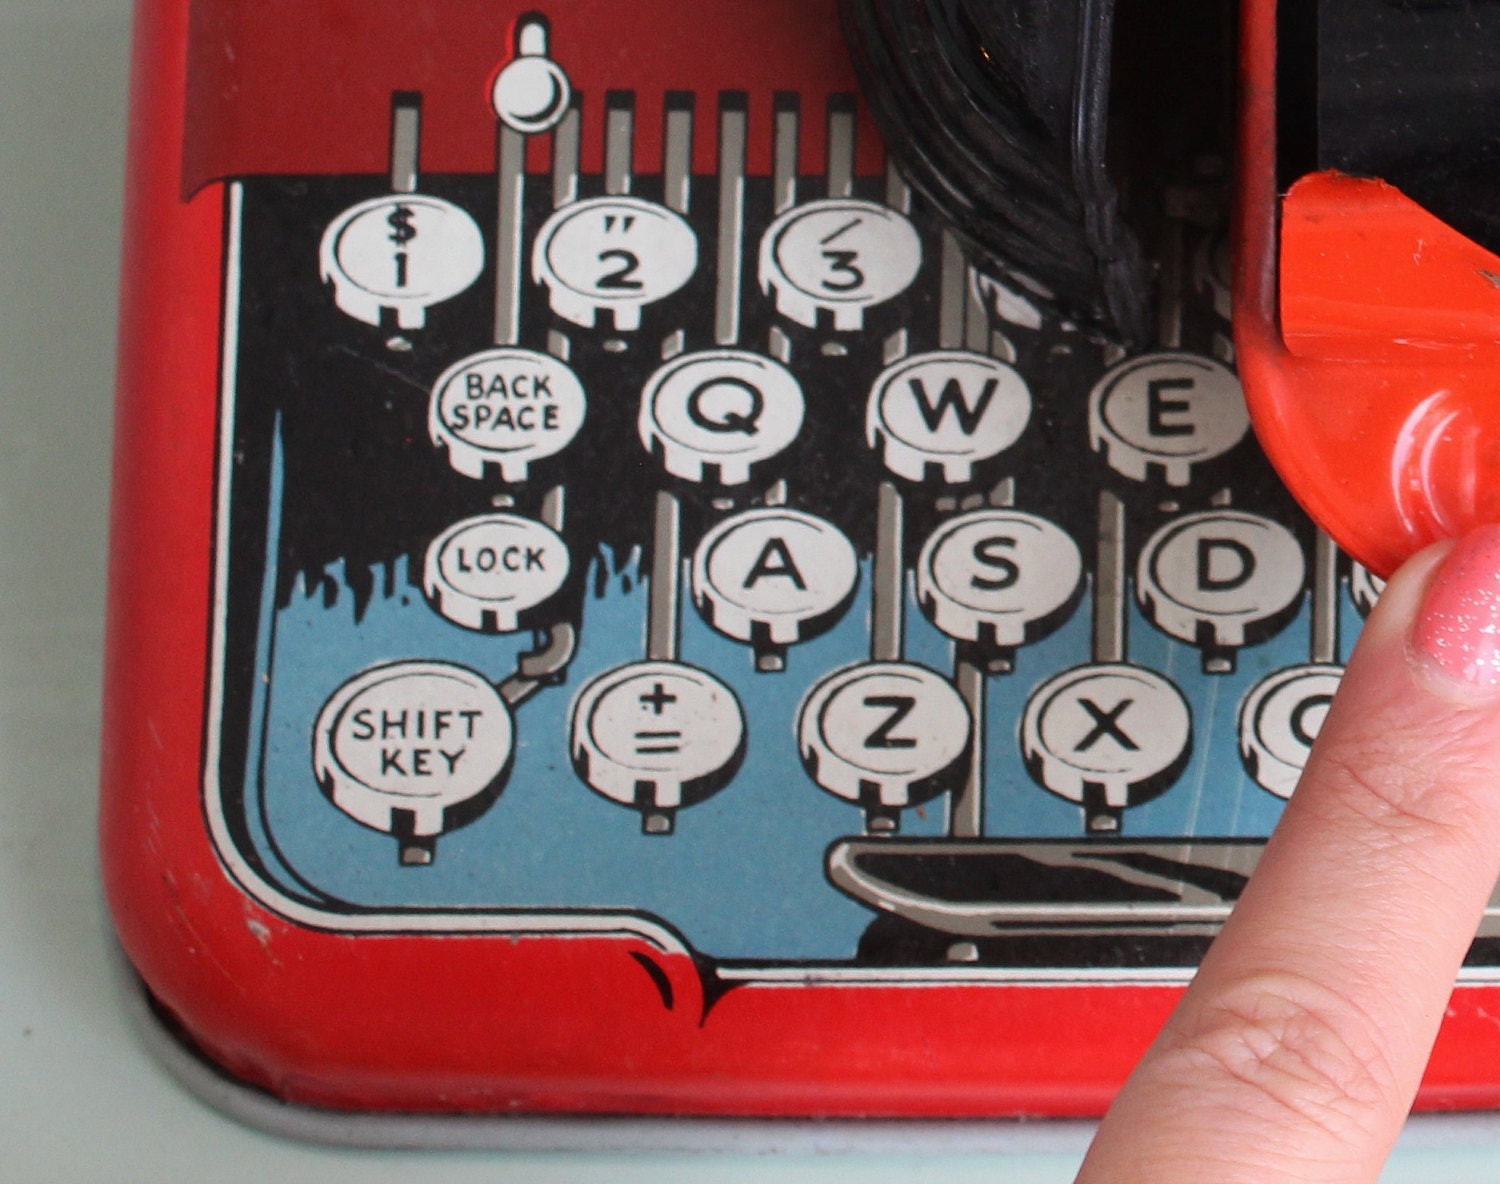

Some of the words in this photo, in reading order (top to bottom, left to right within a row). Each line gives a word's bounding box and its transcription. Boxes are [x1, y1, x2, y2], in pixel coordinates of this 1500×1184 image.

[596, 250, 643, 289] 2
[822, 251, 864, 291] 3
[467, 374, 551, 400] BACK
[687, 377, 763, 436] Q
[909, 378, 998, 435] W
[1148, 377, 1195, 436] E
[451, 404, 560, 432] SPACE
[458, 546, 544, 572] LOCK
[743, 538, 806, 590] A
[971, 537, 1019, 590] S
[1197, 538, 1255, 591] D
[353, 709, 482, 740] SHIFT
[864, 696, 916, 748] Z
[1075, 698, 1139, 751] X
[382, 749, 465, 775] KEY
